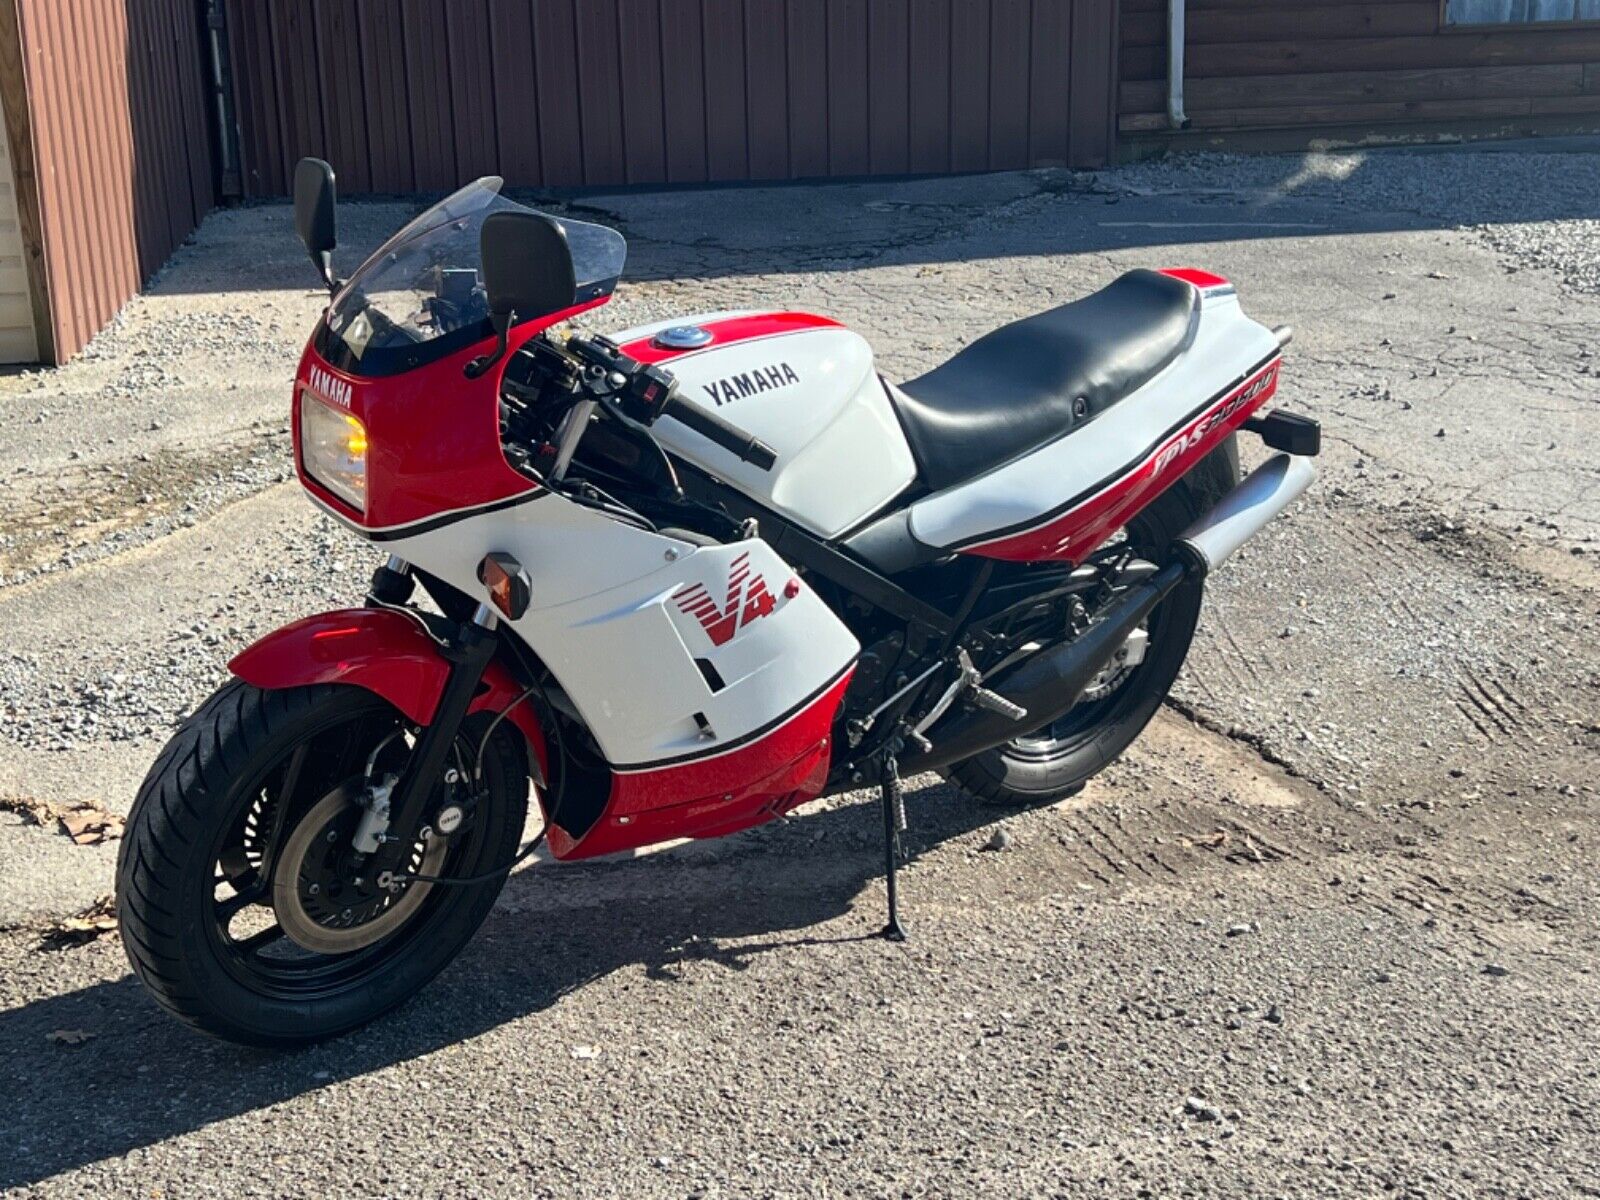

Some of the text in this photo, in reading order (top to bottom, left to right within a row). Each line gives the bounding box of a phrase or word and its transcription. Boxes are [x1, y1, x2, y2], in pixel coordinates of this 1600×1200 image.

[309, 364, 353, 409] YAMAHA
[702, 362, 800, 407] YAMAHA
[672, 551, 777, 647] V4
